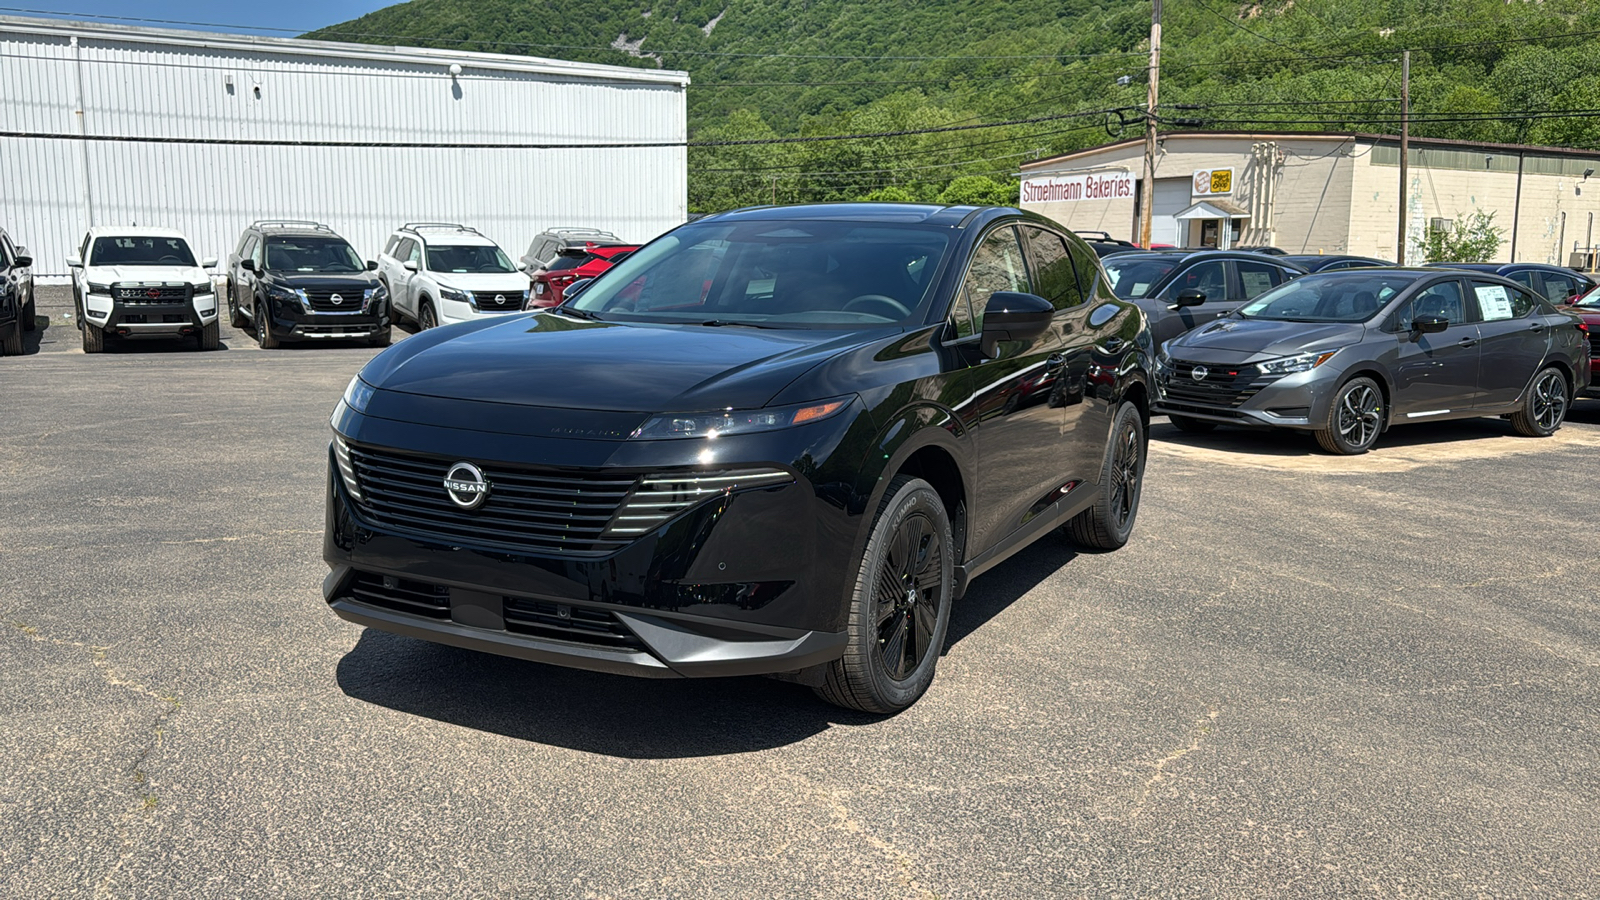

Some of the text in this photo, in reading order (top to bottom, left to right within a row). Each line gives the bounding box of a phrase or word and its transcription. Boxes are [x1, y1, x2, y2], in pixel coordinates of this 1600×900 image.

[1023, 180, 1082, 202] Stroehmann
[443, 480, 486, 492] NISSAN
[892, 497, 917, 530] KUMHO
